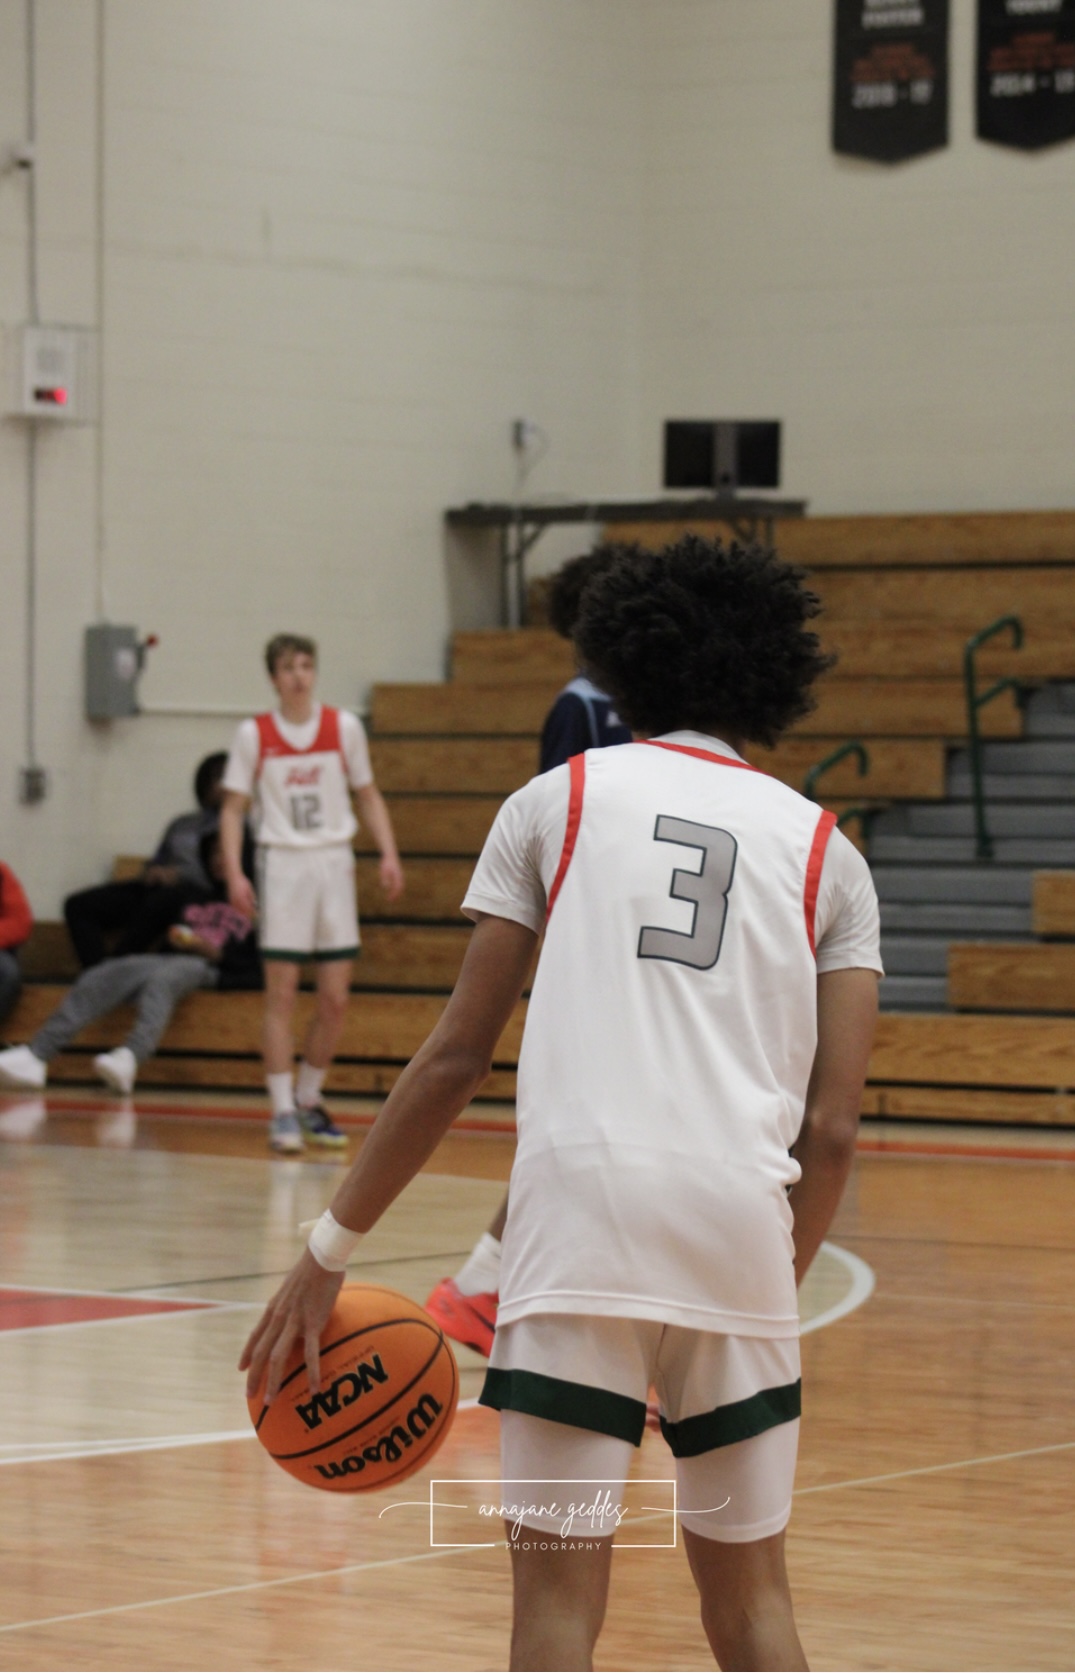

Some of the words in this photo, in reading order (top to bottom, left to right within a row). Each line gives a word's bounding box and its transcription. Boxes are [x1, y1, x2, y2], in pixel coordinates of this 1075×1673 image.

[290, 794, 322, 831] 12
[637, 814, 738, 971] 3
[295, 1353, 389, 1430] NCAA
[313, 1392, 444, 1481] Wilson
